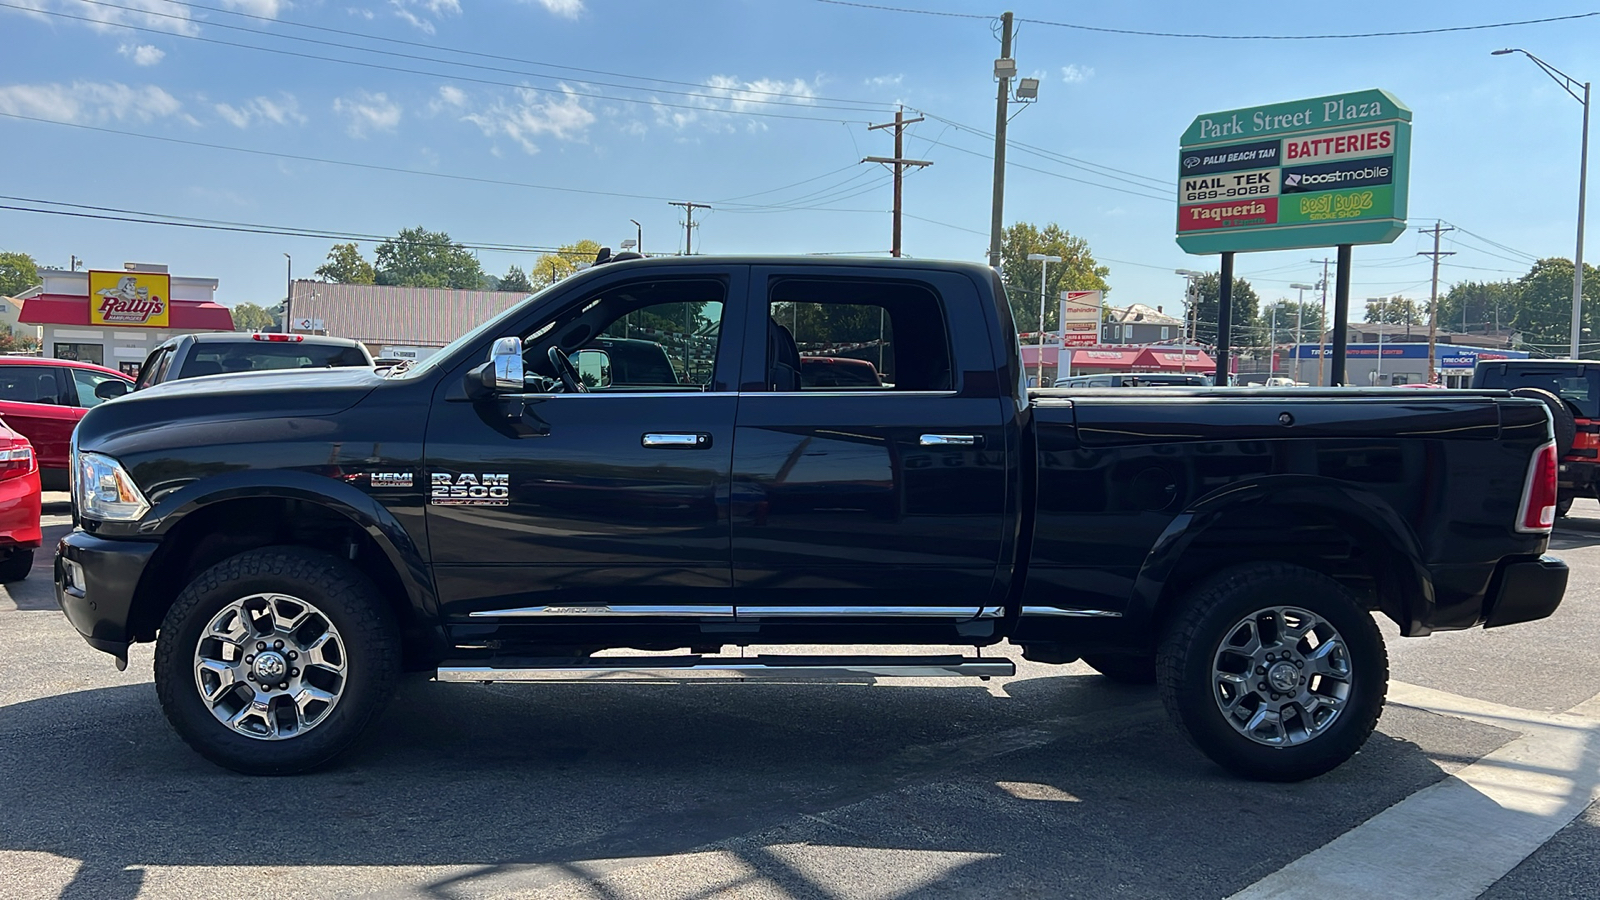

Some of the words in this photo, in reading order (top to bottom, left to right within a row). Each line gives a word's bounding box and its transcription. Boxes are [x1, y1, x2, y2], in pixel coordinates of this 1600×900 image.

[1200, 115, 1243, 139] Park
[1253, 108, 1312, 132] Street
[1323, 99, 1382, 122] Plaza
[1287, 130, 1391, 159] BATTERIES
[1203, 154, 1227, 165] PALM
[1227, 150, 1256, 163] BEACH
[1258, 148, 1276, 159] TAN
[1185, 178, 1226, 191] NAIL
[1233, 172, 1271, 186] TEK
[1187, 185, 1270, 201] 689-9088
[1334, 191, 1373, 211] BUDZ
[1309, 211, 1337, 220] SMOKE
[1338, 210, 1361, 218] SHOP
[98, 296, 164, 321] Rally's
[371, 473, 413, 481] HEMI
[431, 473, 509, 485] RAM
[431, 486, 509, 498] 2500
